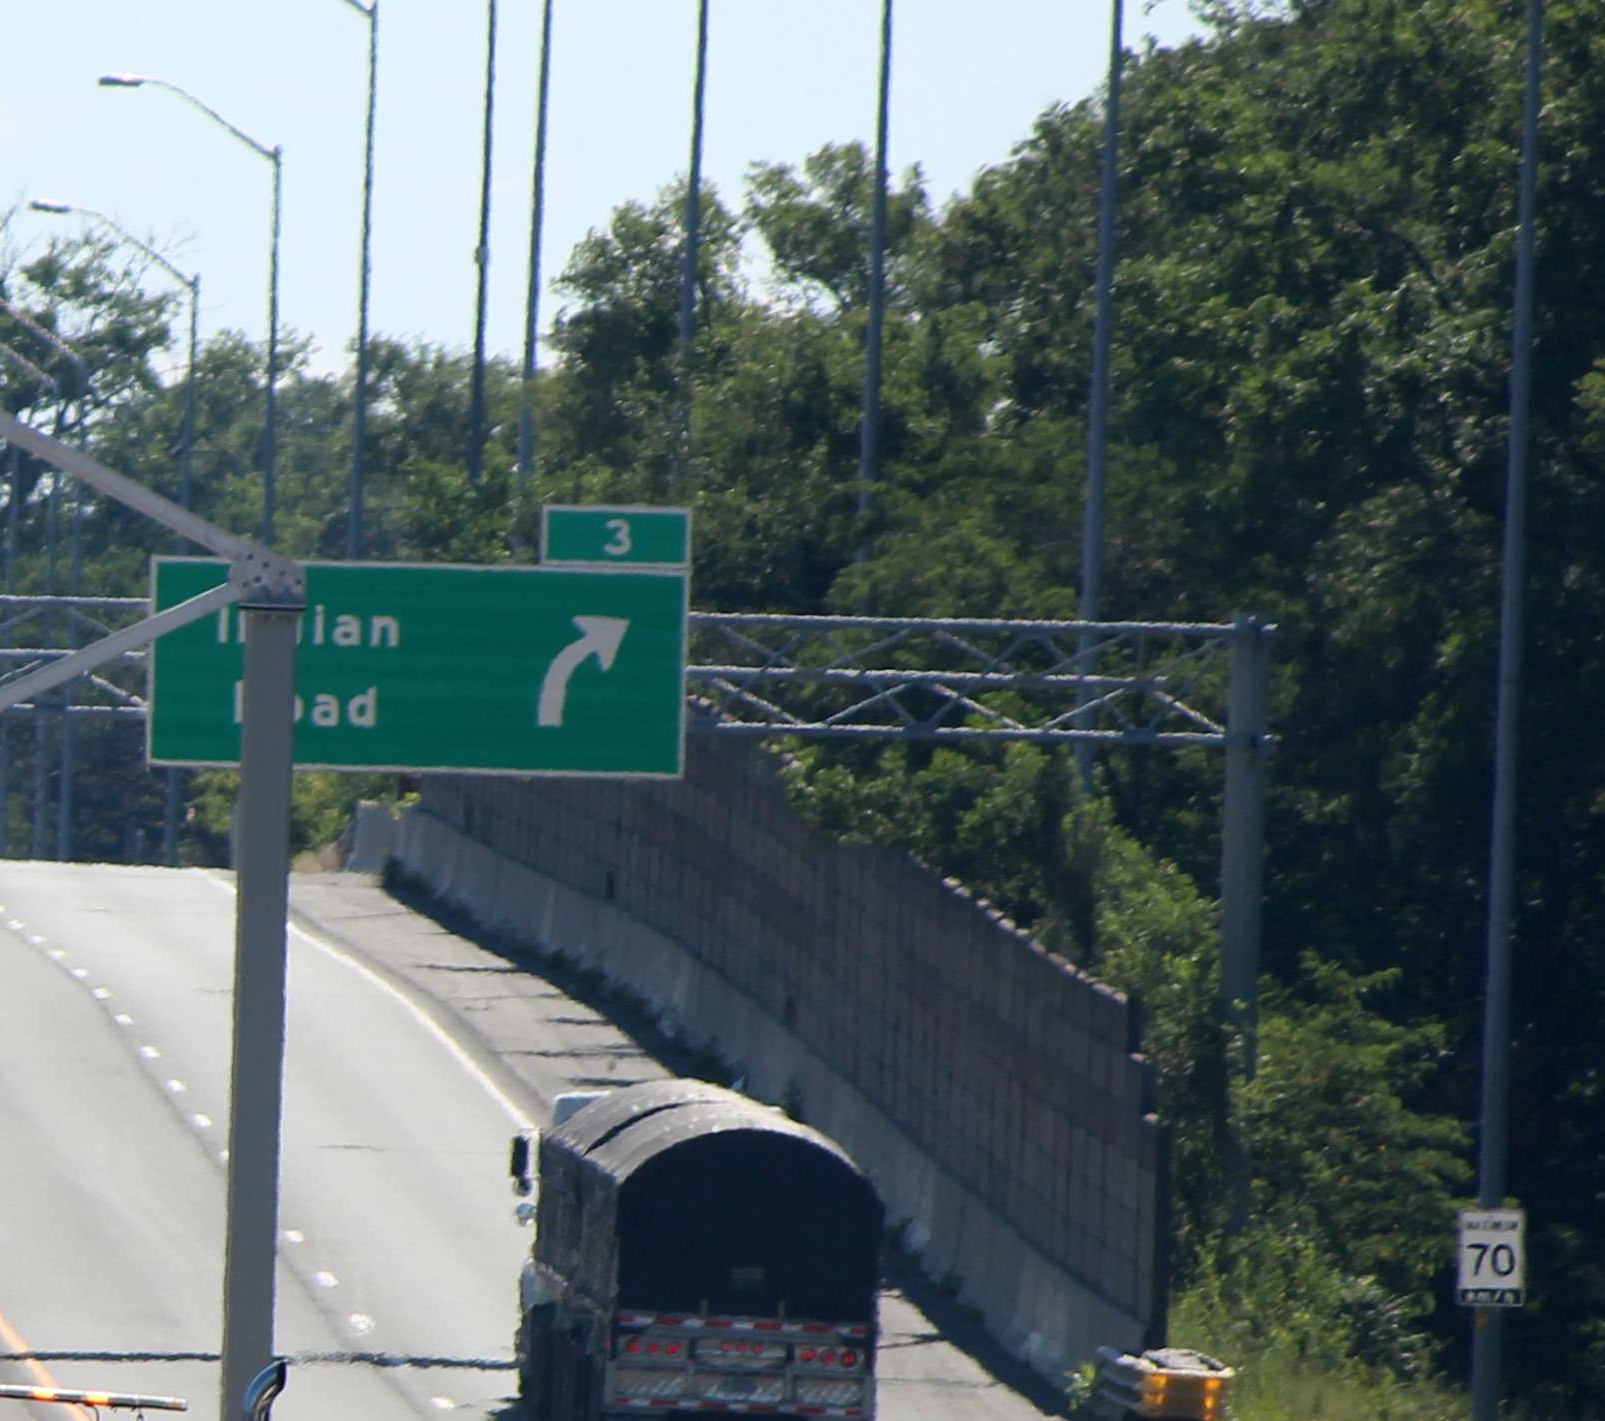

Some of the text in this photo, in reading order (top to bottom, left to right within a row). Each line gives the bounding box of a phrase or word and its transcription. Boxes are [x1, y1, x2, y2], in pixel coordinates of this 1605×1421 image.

[604, 519, 631, 556] 3
[218, 604, 400, 647] Iian
[234, 680, 378, 728] ad
[1466, 1243, 1516, 1277] 70
